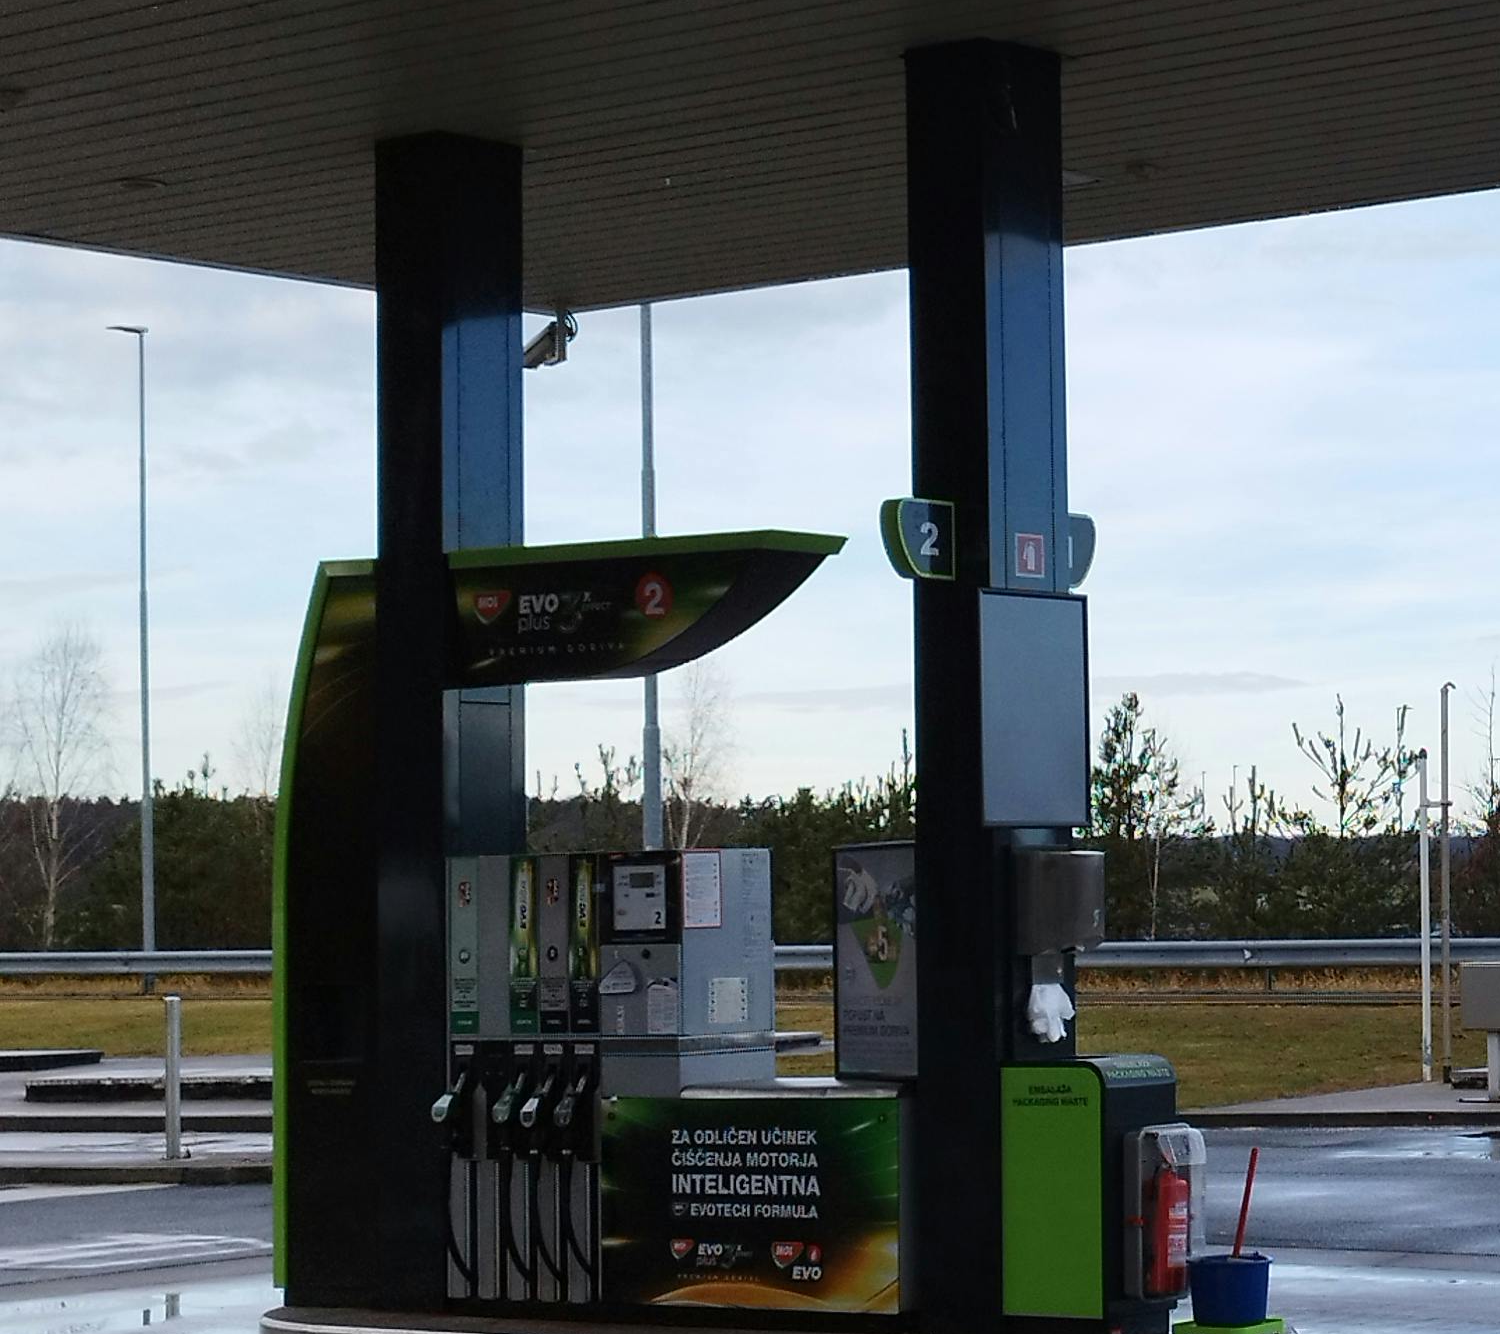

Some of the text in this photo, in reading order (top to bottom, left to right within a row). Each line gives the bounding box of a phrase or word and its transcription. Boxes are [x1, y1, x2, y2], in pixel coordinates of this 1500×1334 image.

[920, 522, 940, 556] 2
[518, 592, 559, 615] EVO
[644, 581, 665, 615] 2
[517, 615, 551, 634] plus
[654, 911, 662, 925] 2
[671, 1126, 818, 1145] ZA ODLIČEN UČINEK
[671, 1148, 819, 1168] ČIŠČENJA MOTORJA
[671, 1173, 821, 1196] INTELIGENTNA
[690, 1203, 750, 1217] EVOTECH
[754, 1203, 819, 1218] FORMULA
[697, 1243, 723, 1255] EVO
[791, 1266, 822, 1280] EVO
